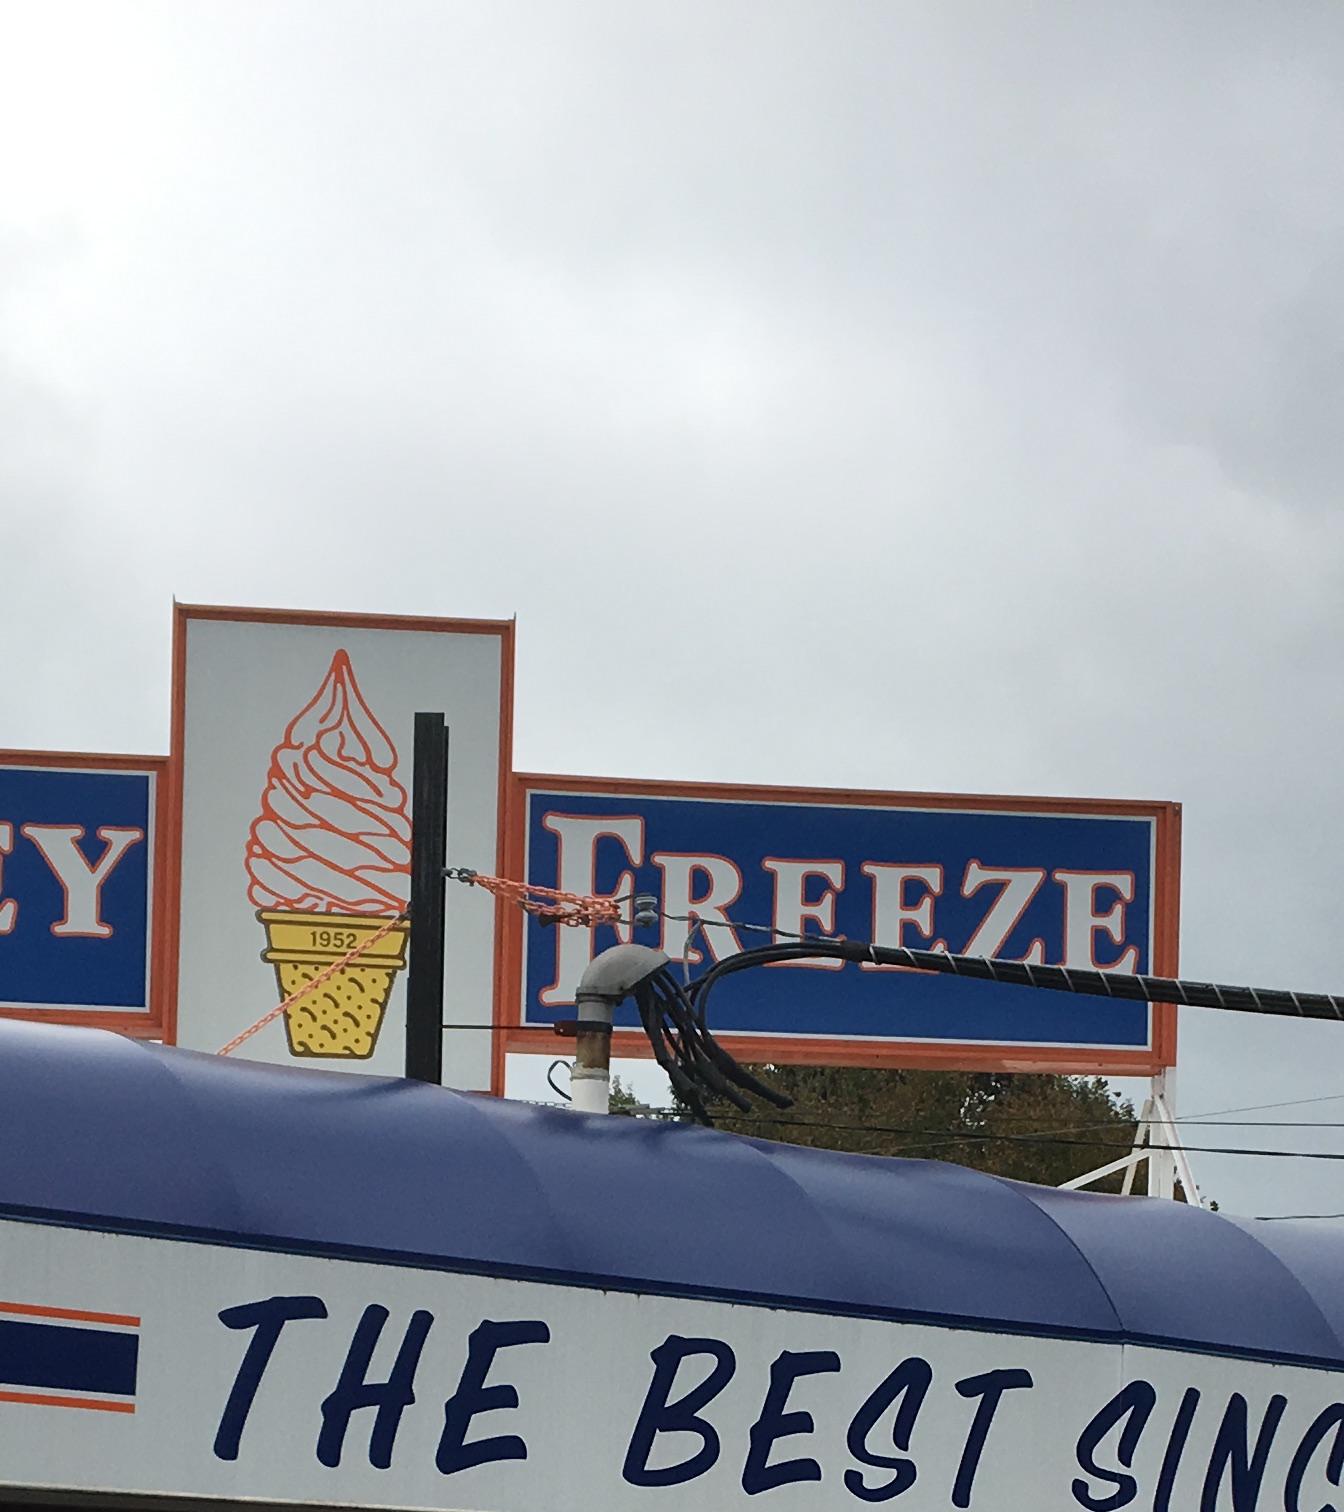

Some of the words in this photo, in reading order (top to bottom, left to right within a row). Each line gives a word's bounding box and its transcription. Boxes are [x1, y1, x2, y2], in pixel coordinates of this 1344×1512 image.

[310, 930, 359, 950] 1952
[542, 811, 1139, 1006] FREEZE
[214, 1296, 550, 1475] THE
[623, 1335, 1033, 1508] BEST
